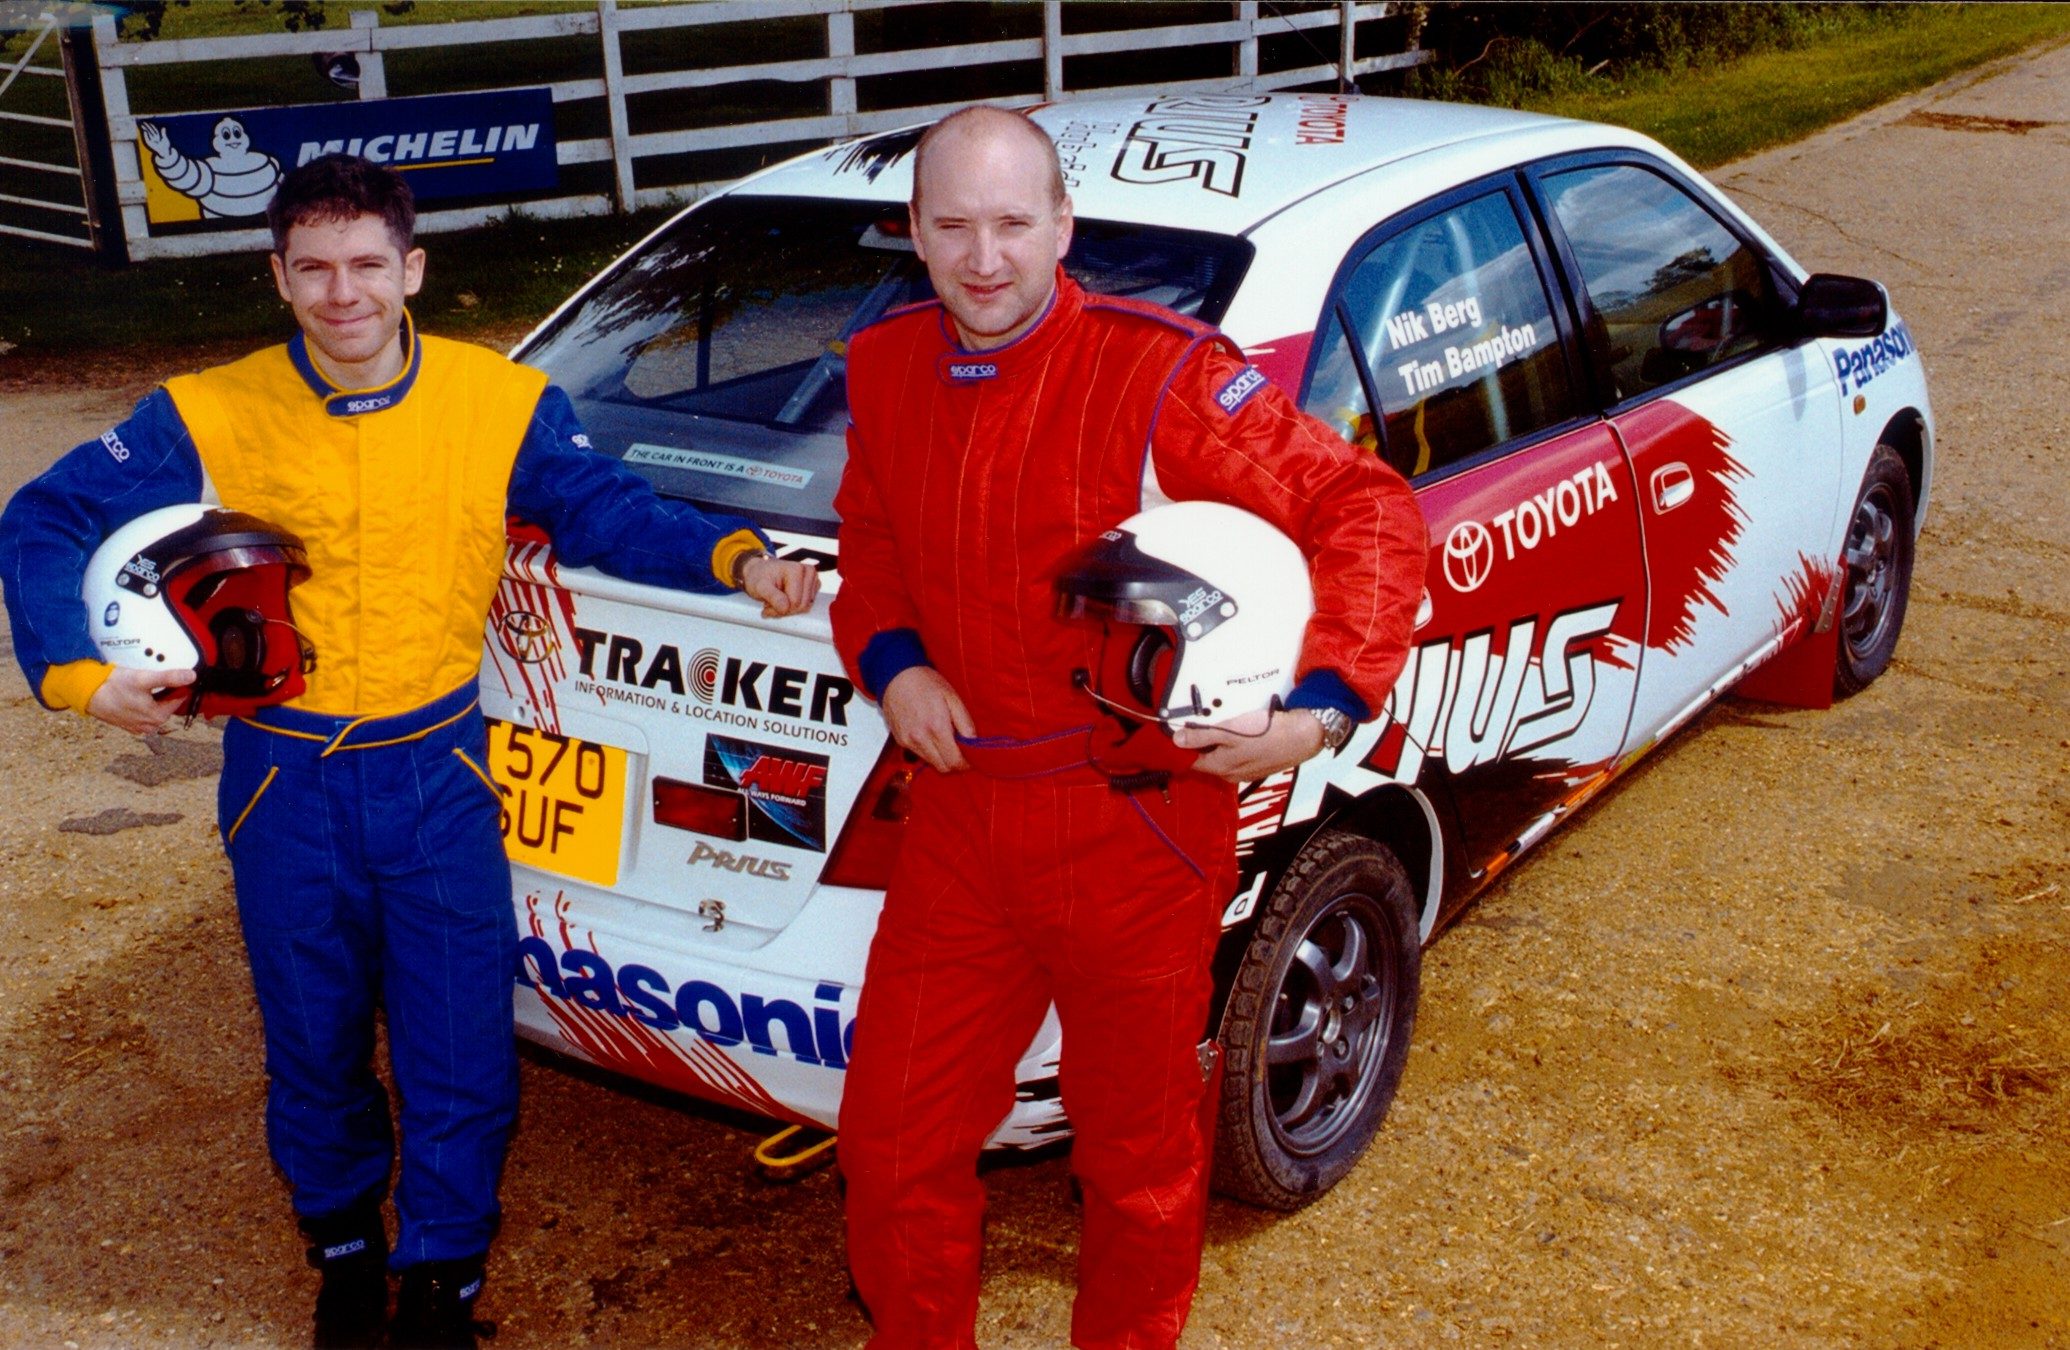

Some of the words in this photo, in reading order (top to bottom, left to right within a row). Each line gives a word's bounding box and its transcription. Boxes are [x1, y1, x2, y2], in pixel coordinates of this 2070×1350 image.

[297, 123, 540, 167] MICHELIN
[1386, 310, 1429, 350] Nik
[1427, 297, 1483, 334] Berg
[950, 365, 997, 378] sparco
[1398, 360, 1444, 396] Tim
[1445, 323, 1536, 378] Bampton
[101, 429, 130, 463] arco
[631, 449, 651, 459] THE
[651, 452, 673, 462] CAR
[673, 455, 687, 464] IN
[686, 456, 725, 469] FRONT
[724, 463, 736, 472] IS
[735, 465, 745, 473] A
[763, 469, 804, 484] TOYOTA
[1493, 461, 1618, 560] TOYOTA
[575, 627, 854, 726] TRACKER
[1226, 668, 1280, 686] PELTOR
[574, 680, 667, 711] INFORMATION
[671, 701, 681, 714] &
[685, 704, 758, 730] LOCATION
[763, 719, 849, 747] SOLUTIONS
[740, 755, 828, 799] AWF
[750, 789, 770, 800] WAYS
[770, 793, 807, 808] FORWARD
[515, 936, 858, 1070] nasoni
